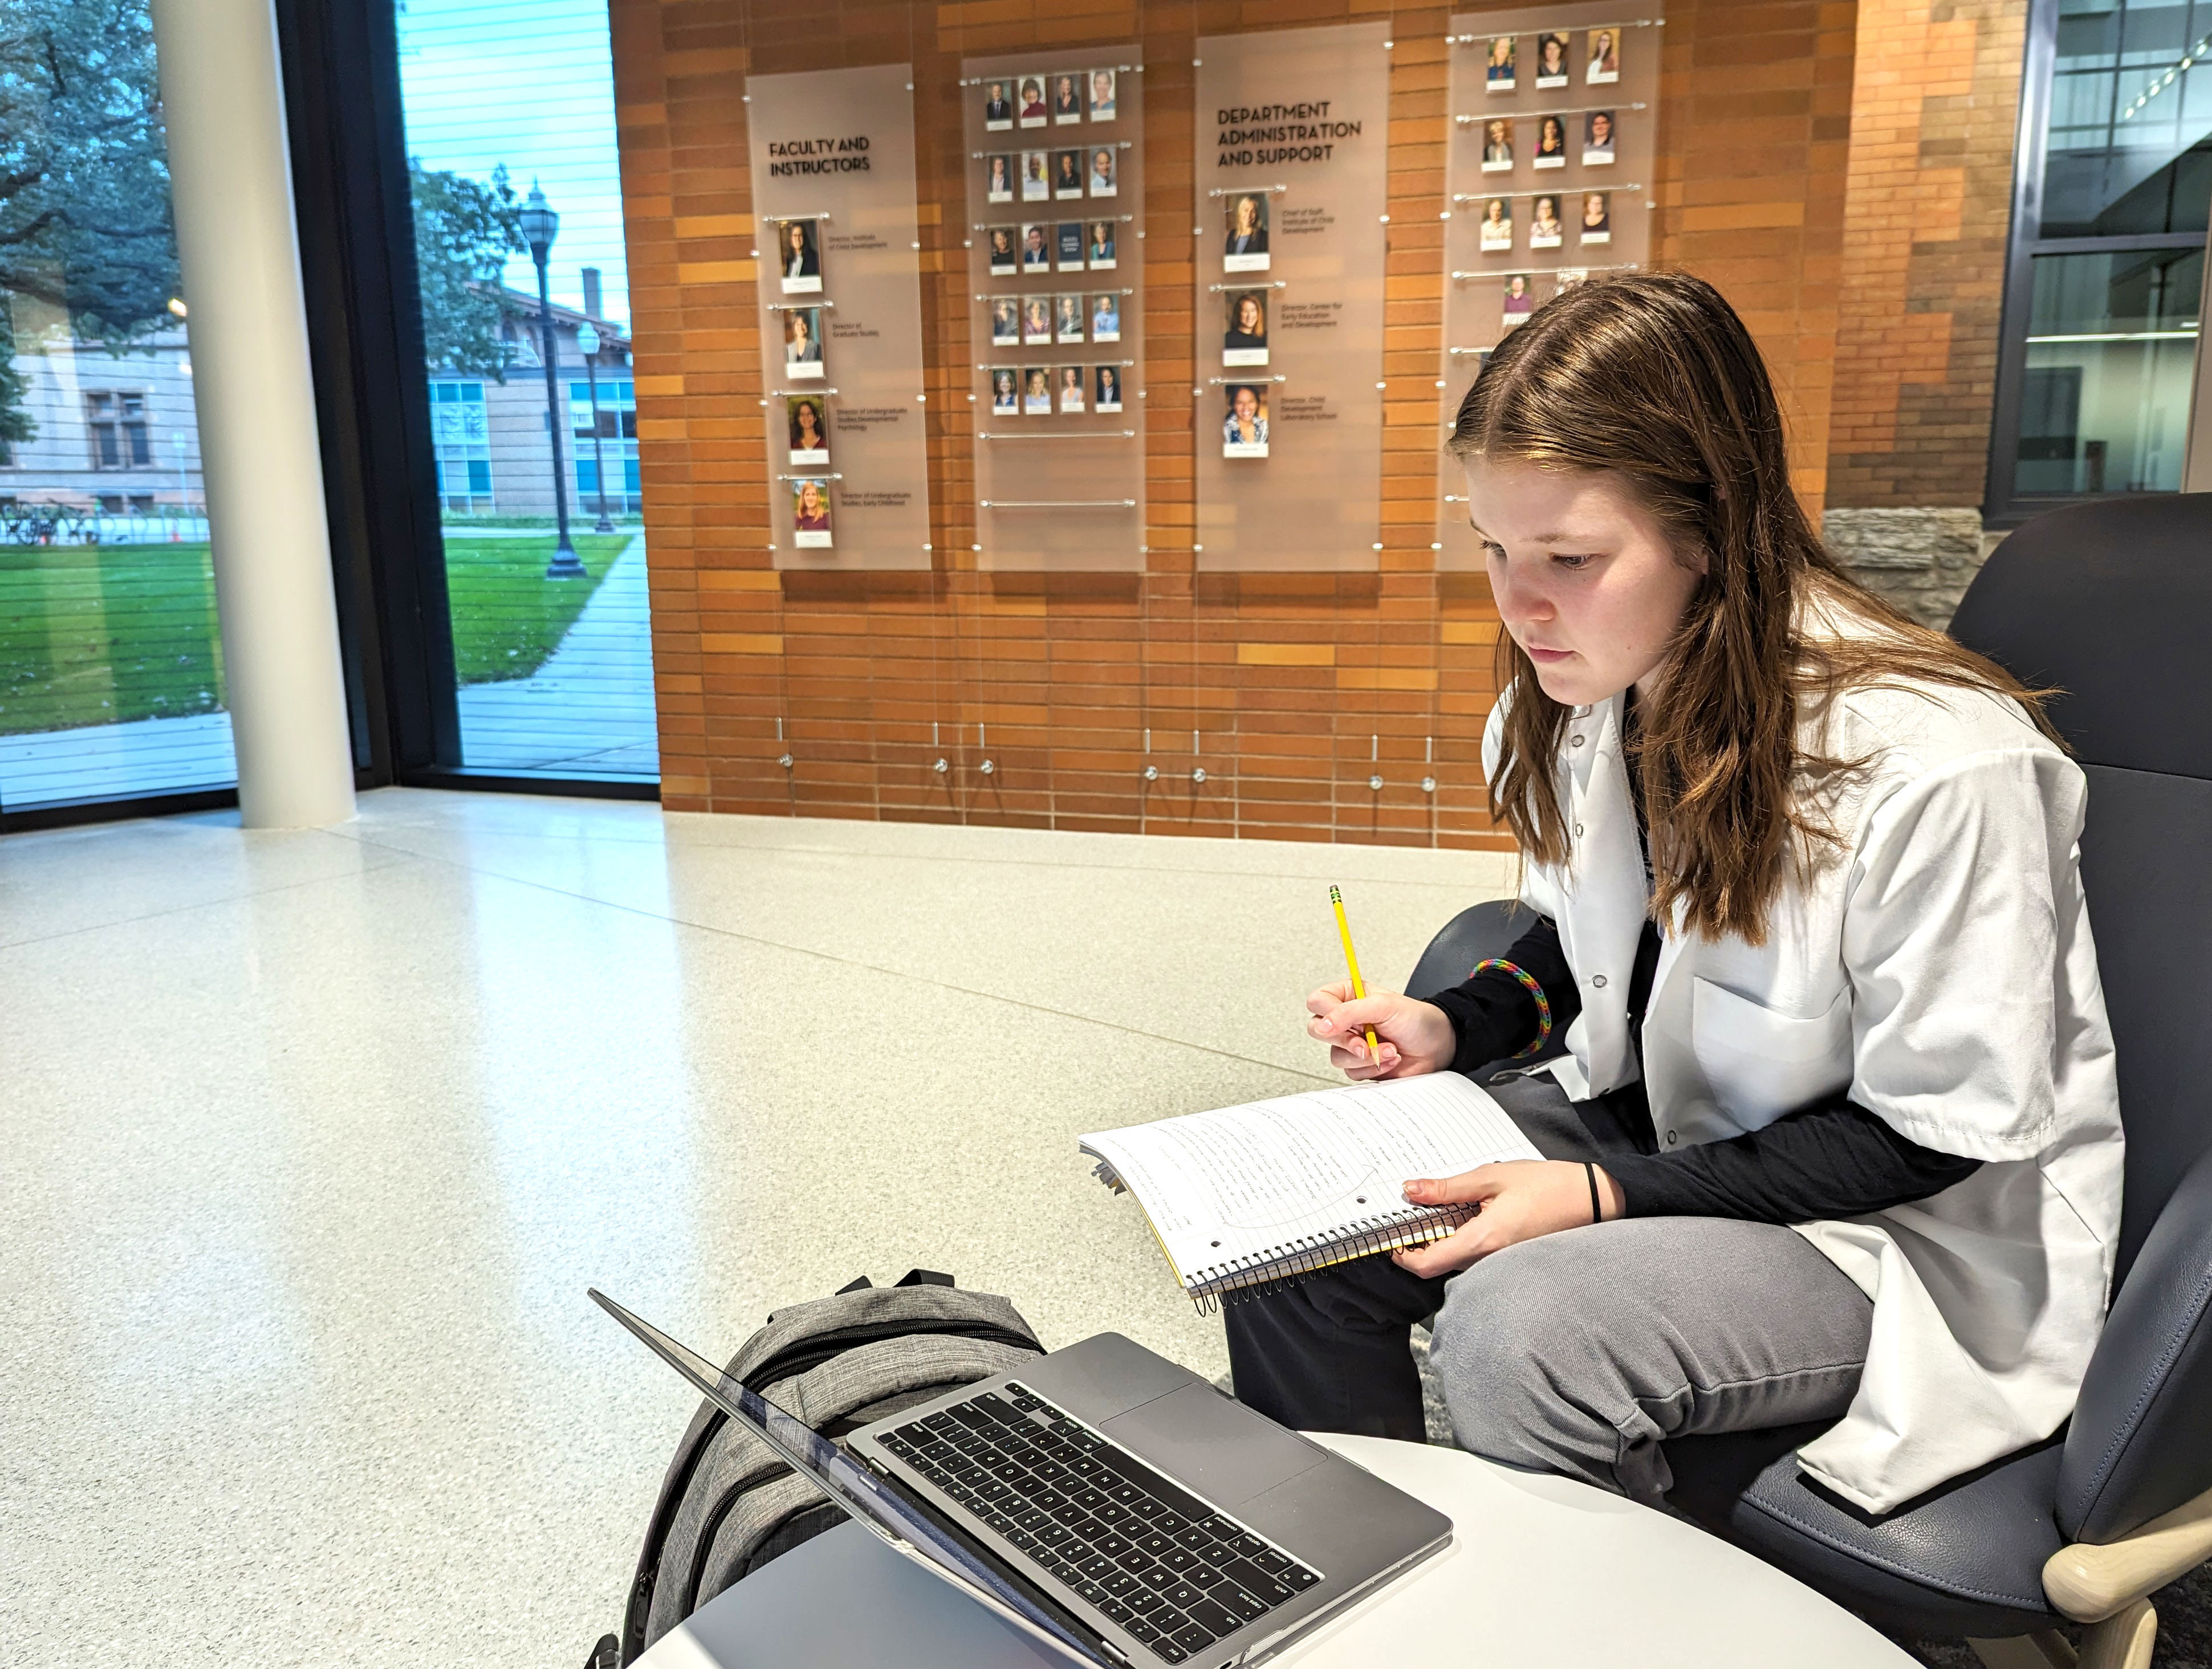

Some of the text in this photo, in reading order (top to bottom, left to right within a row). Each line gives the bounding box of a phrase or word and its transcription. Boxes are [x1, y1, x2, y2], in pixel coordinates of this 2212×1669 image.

[1217, 101, 1331, 125] DEPARTMENT
[1218, 121, 1363, 146] ADMINISTRATION
[770, 136, 869, 157] FACULTY AND
[1218, 145, 1333, 167] AND SUPPORT
[771, 156, 870, 177] INSTRUCTORS
[1065, 1419, 1079, 1428] option
[1083, 1431, 1102, 1444] command
[1215, 1516, 1238, 1532] command
[1245, 1535, 1260, 1546] option
[1268, 1551, 1287, 1563] control
[1275, 1584, 1287, 1594] shift
[1250, 1597, 1262, 1609] caps
